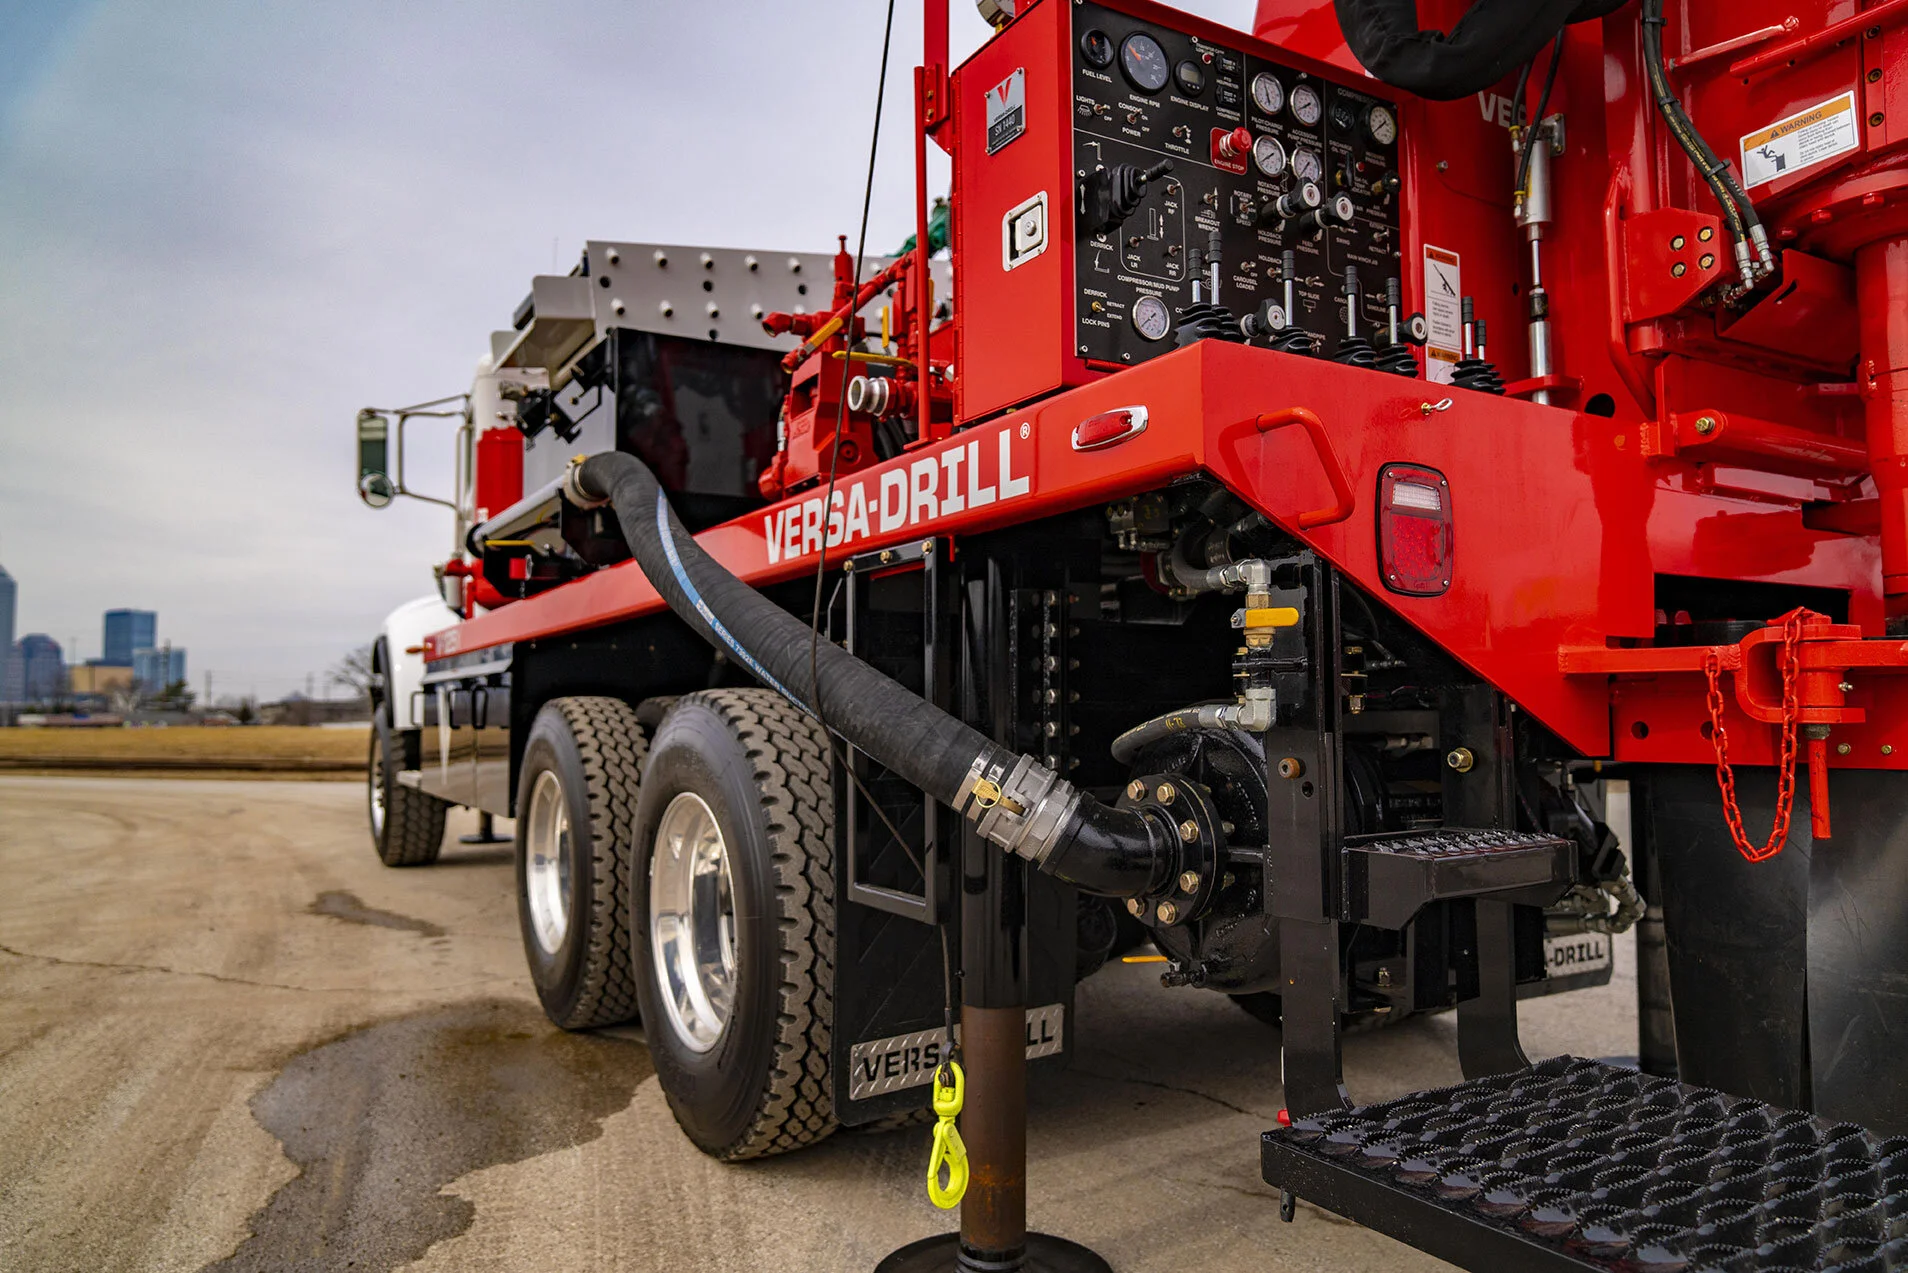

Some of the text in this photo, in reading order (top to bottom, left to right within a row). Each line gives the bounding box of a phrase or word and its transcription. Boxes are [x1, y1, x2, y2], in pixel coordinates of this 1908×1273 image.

[1082, 68, 1112, 83] FUEL LEVEL
[1076, 94, 1095, 106] LIGHTS
[1129, 94, 1160, 108] ENGINE RPM
[1170, 96, 1209, 112] ENGINE DISPLAY
[1780, 111, 1822, 134] WARNING
[1122, 126, 1141, 138] POWER
[1164, 142, 1190, 154] THROTTLE
[1214, 158, 1232, 168] ENGINE
[1164, 200, 1178, 208] JACK
[1194, 216, 1220, 226] BREAKOUT
[1198, 224, 1219, 232] WRENCH
[1090, 240, 1114, 252] DERRICK
[1127, 254, 1141, 262] JACK
[1258, 254, 1282, 264] HOLDBAC
[1166, 262, 1180, 270] JACK
[1233, 275, 1258, 286] CAROUSEL
[1136, 286, 1163, 298] PRESSURE
[1165, 283, 1180, 292] PUMP
[1236, 283, 1255, 292] LOADER
[1084, 288, 1108, 299] DERRICK
[1082, 318, 1097, 327] LOCK
[765, 428, 1030, 565] VERSA-DRILL
[754, 663, 780, 690] WATER
[780, 687, 820, 720] SUCTION
[1543, 942, 1604, 967] -DRILL
